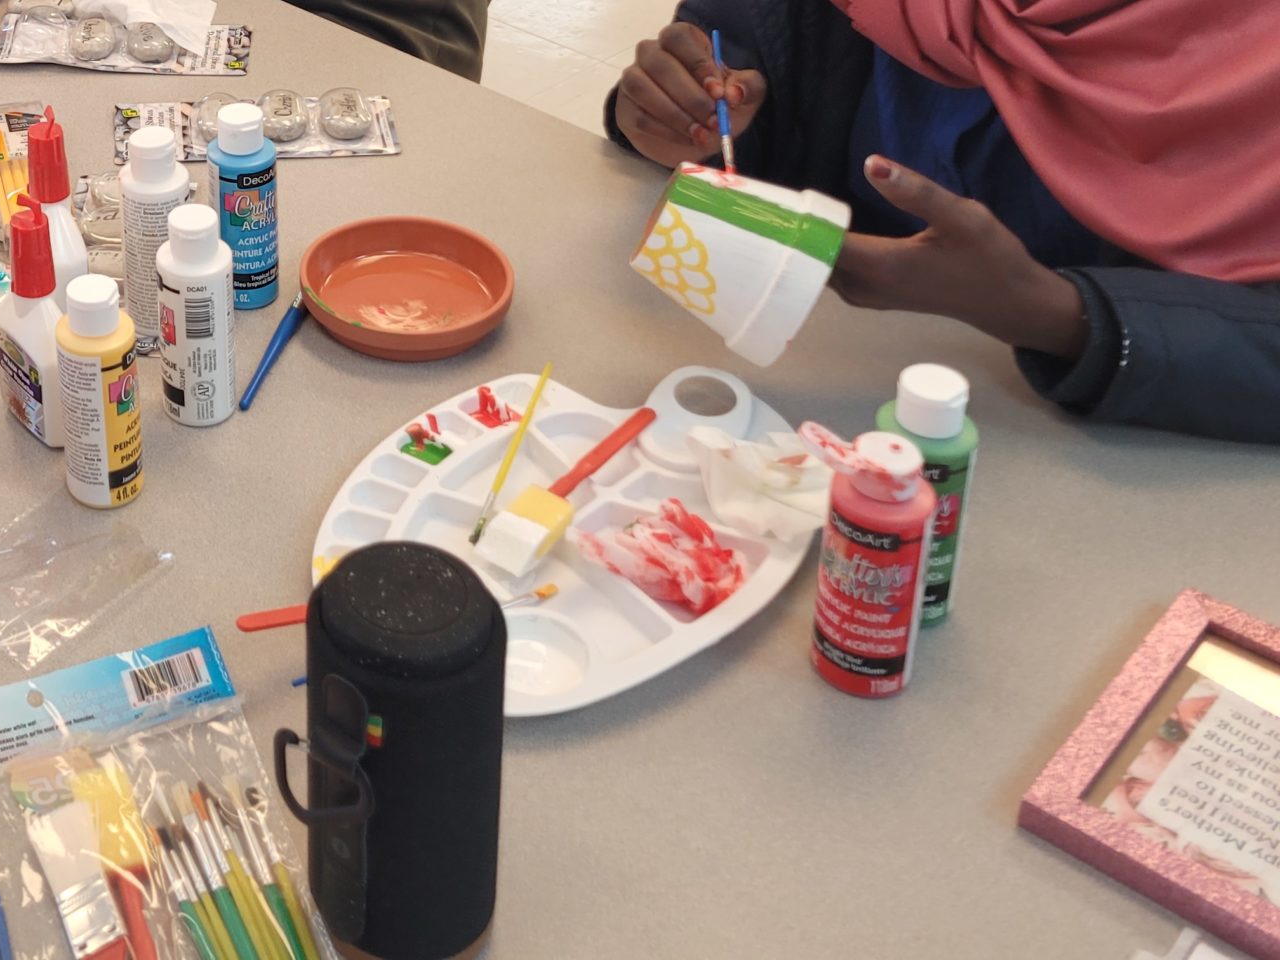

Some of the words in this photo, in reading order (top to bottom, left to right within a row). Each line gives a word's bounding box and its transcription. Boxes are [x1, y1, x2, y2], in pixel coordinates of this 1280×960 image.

[238, 233, 268, 246] ACRYLIC
[116, 491, 121, 502] 4
[832, 511, 892, 549] DecoArt
[1216, 719, 1271, 752] doing
[1192, 743, 1221, 763] for
[1190, 760, 1224, 781] my
[1196, 780, 1216, 796] to
[1227, 778, 1249, 793] as
[1170, 785, 1207, 811] feel
[1210, 807, 1220, 818] I
[1158, 797, 1246, 851] Mother's
